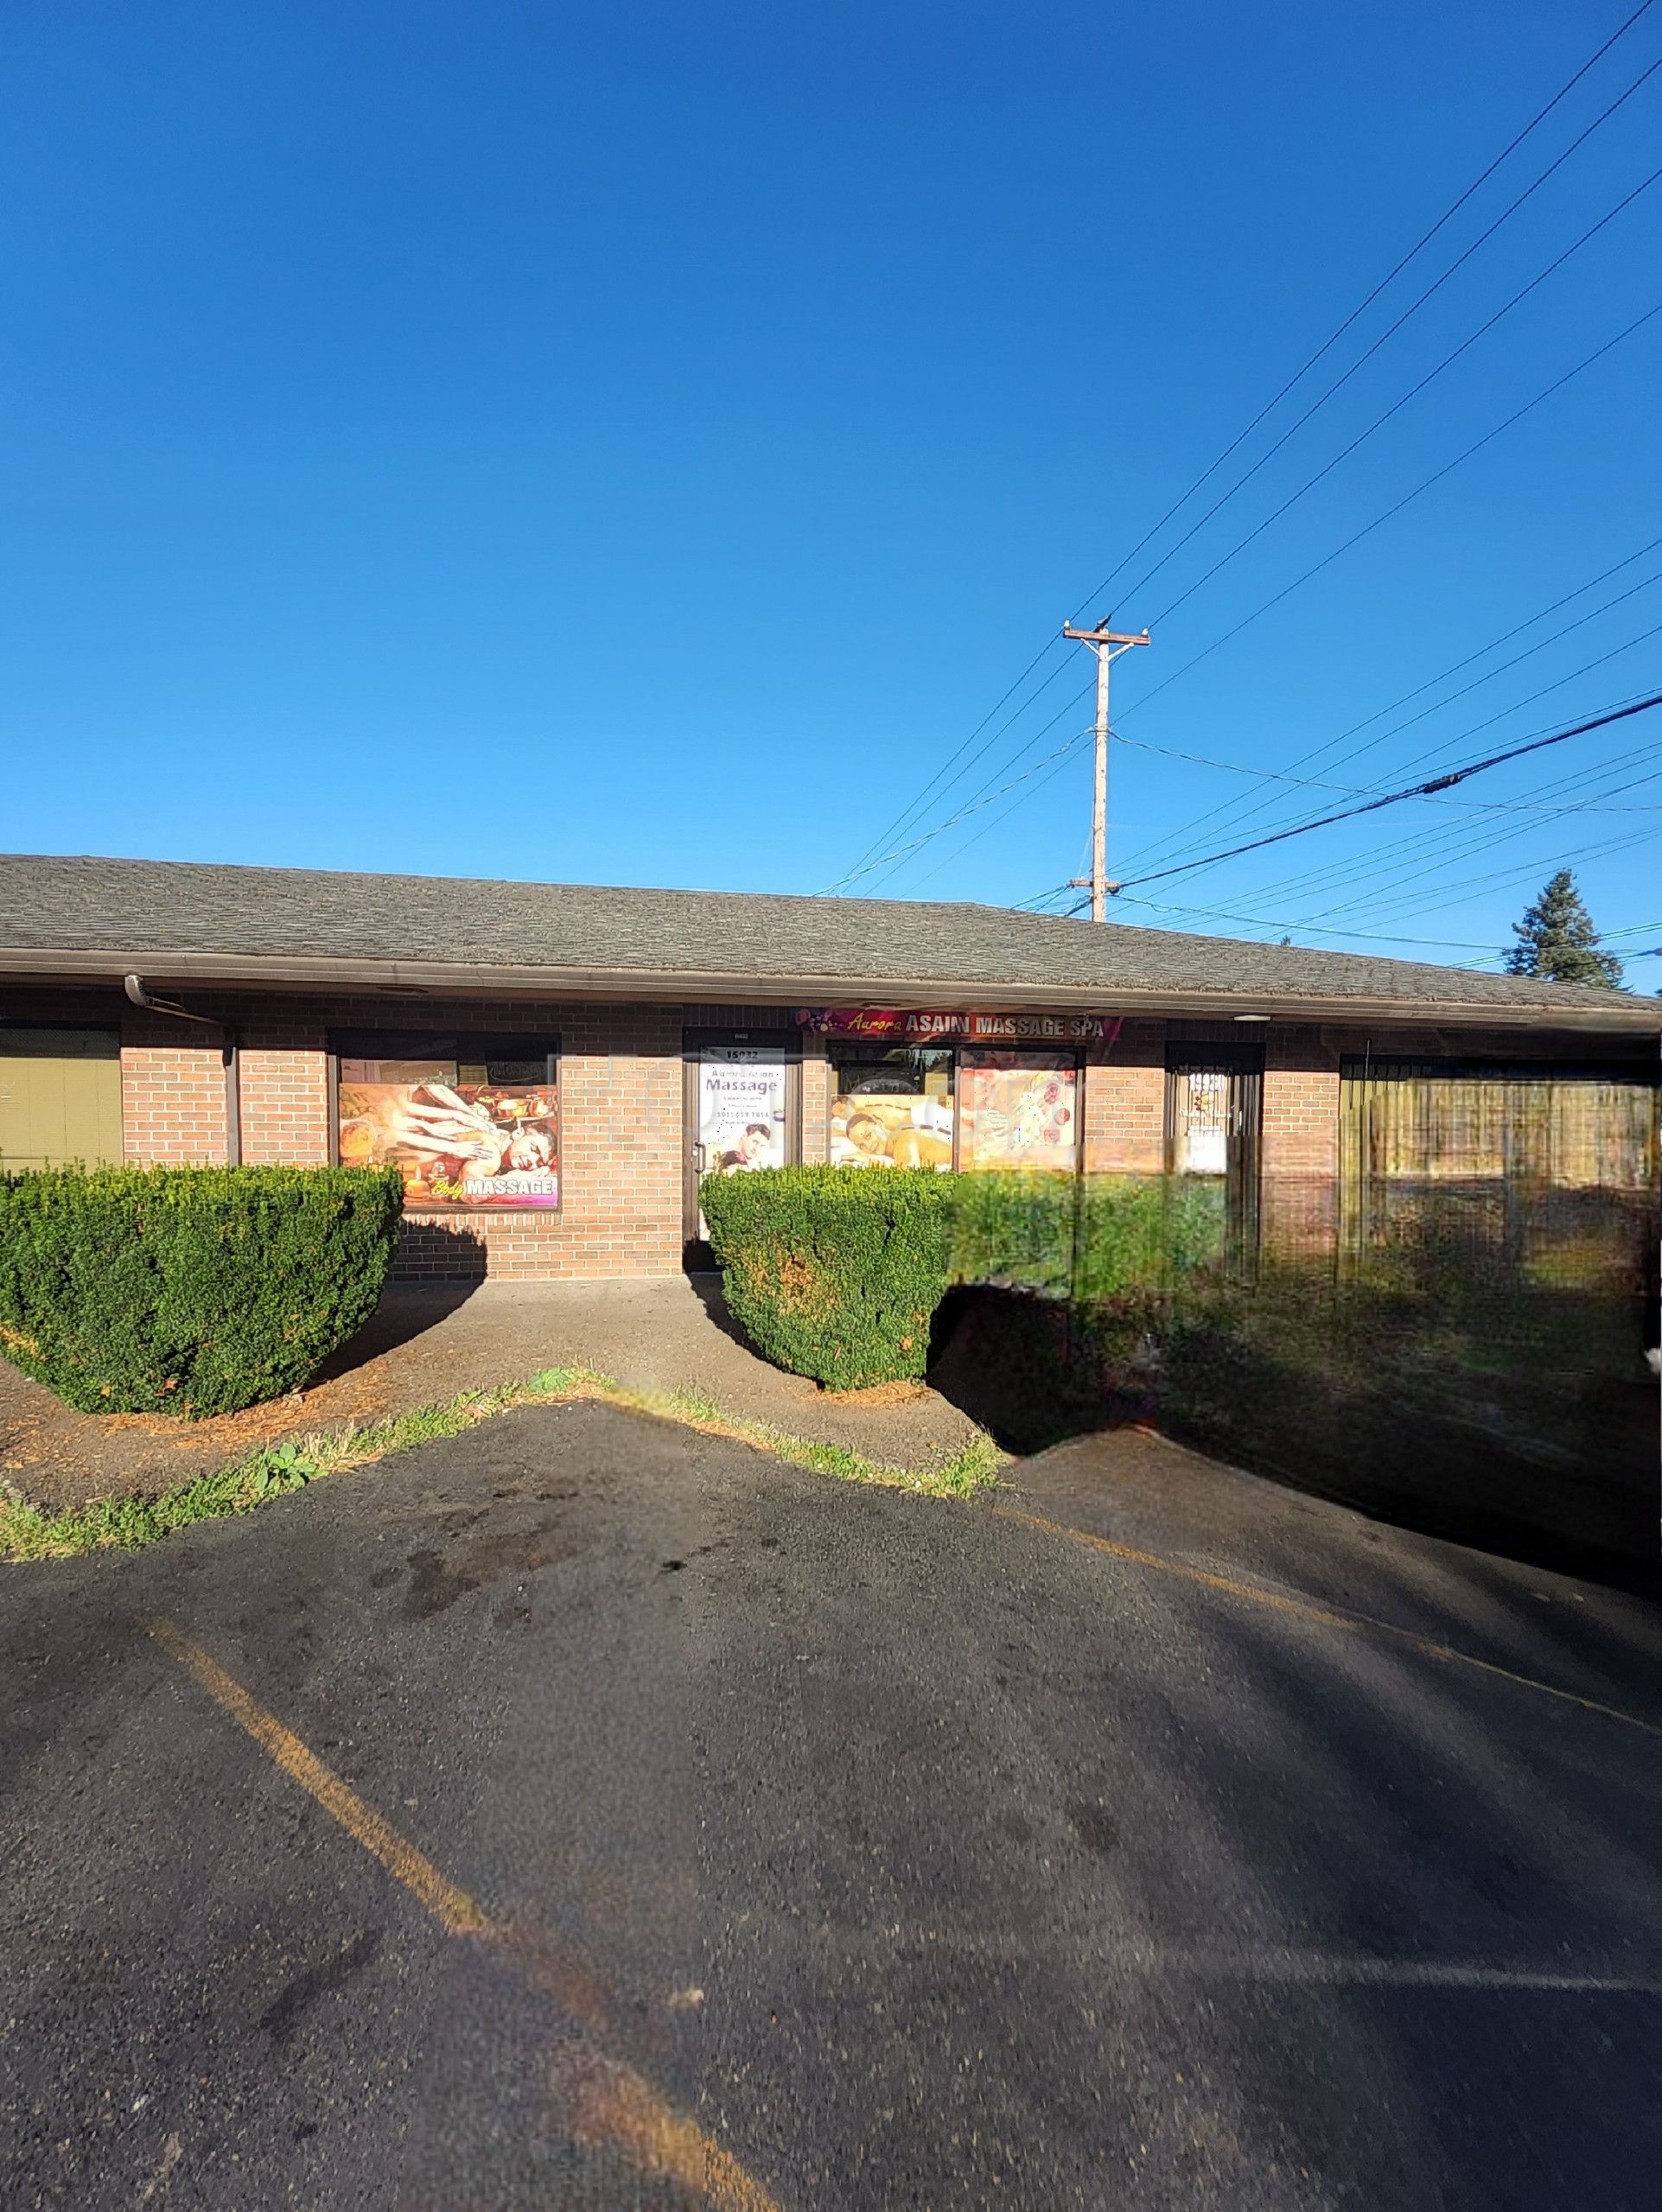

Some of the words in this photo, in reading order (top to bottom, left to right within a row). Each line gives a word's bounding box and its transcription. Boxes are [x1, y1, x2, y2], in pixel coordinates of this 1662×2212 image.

[848, 1012, 901, 1031] Aurora
[976, 1016, 1064, 1036] MASSAGE
[1070, 1018, 1104, 1037] SPA
[706, 1078, 778, 1095] Massage
[431, 1179, 464, 1200] Body
[466, 1179, 553, 1195] MASSAGE
